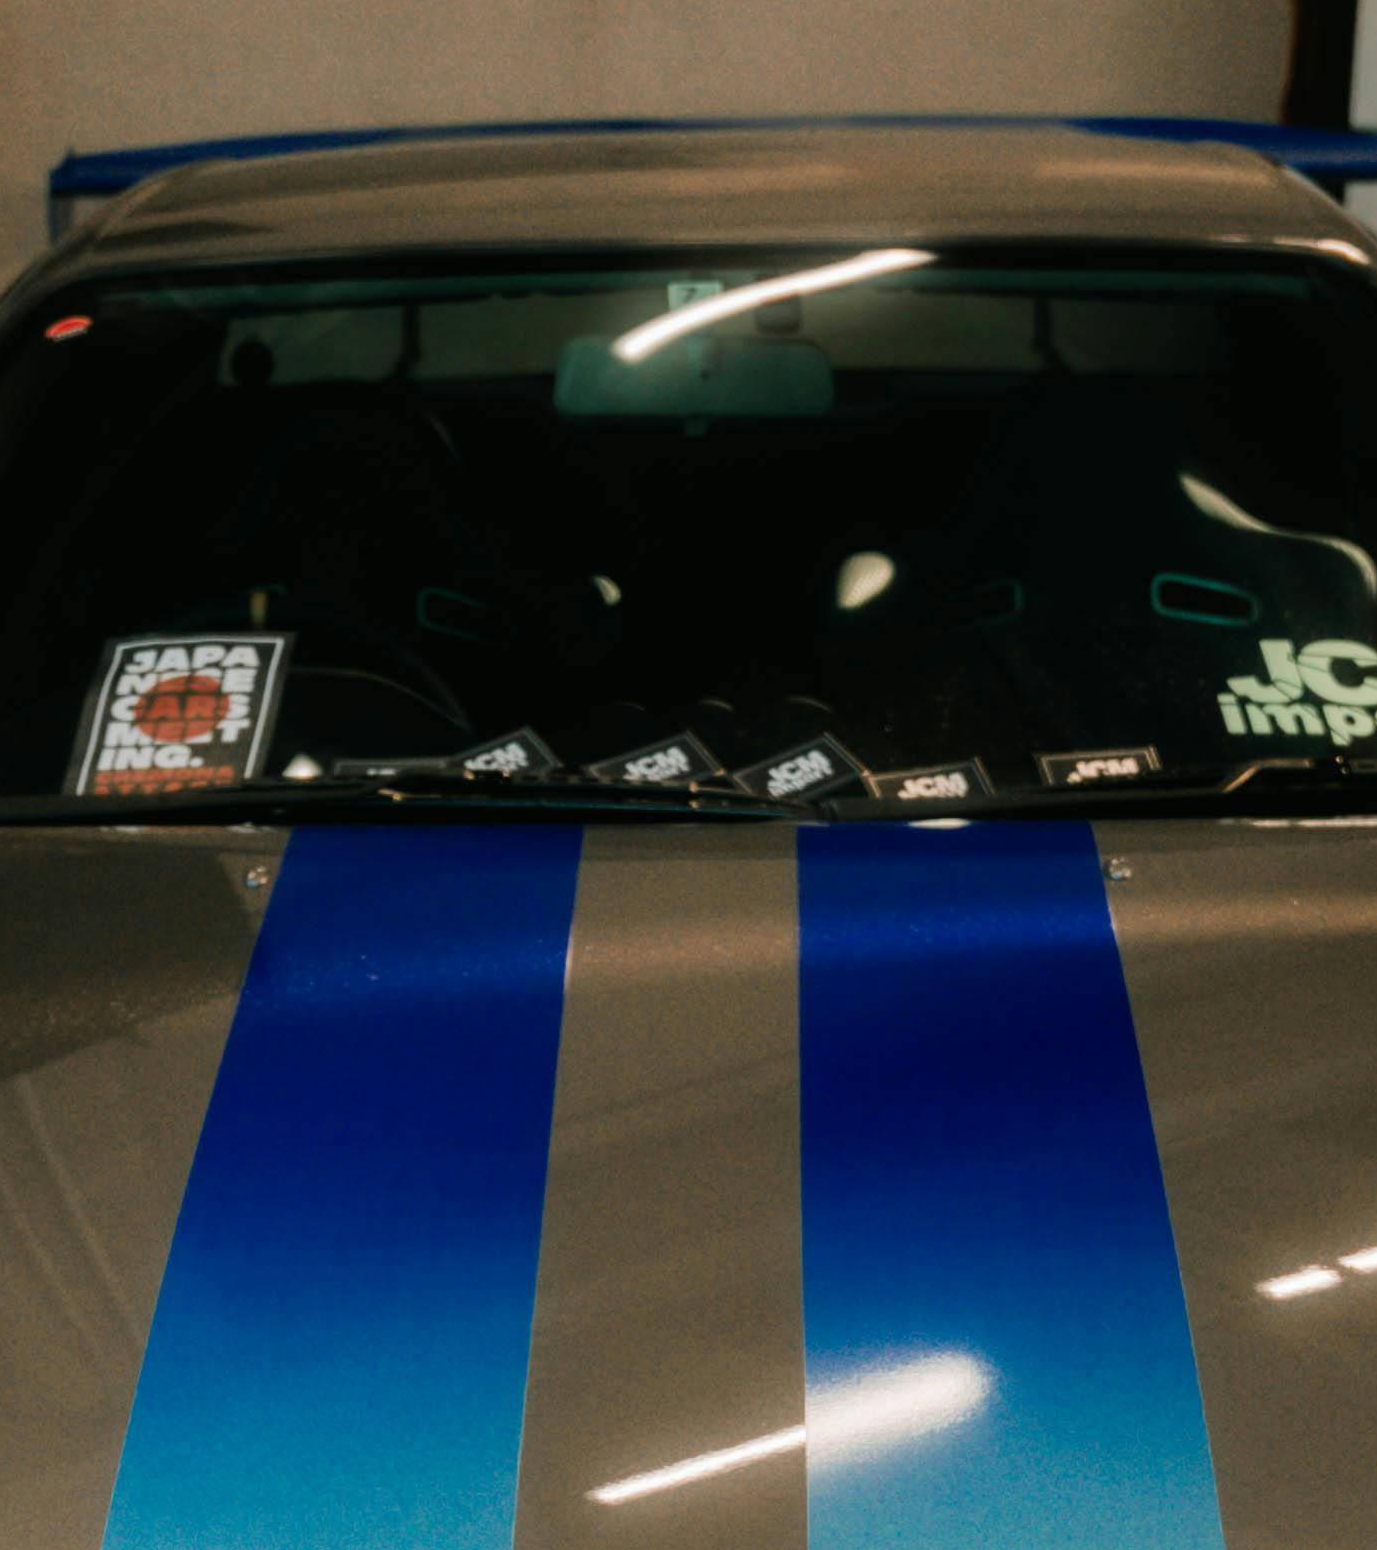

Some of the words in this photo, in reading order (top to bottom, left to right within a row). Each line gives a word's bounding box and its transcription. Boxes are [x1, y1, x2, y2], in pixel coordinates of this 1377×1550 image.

[123, 644, 261, 674] JAPA
[115, 667, 257, 696] NESE
[110, 693, 252, 721] CARS
[104, 718, 252, 747] MEET
[96, 743, 205, 771] ING.
